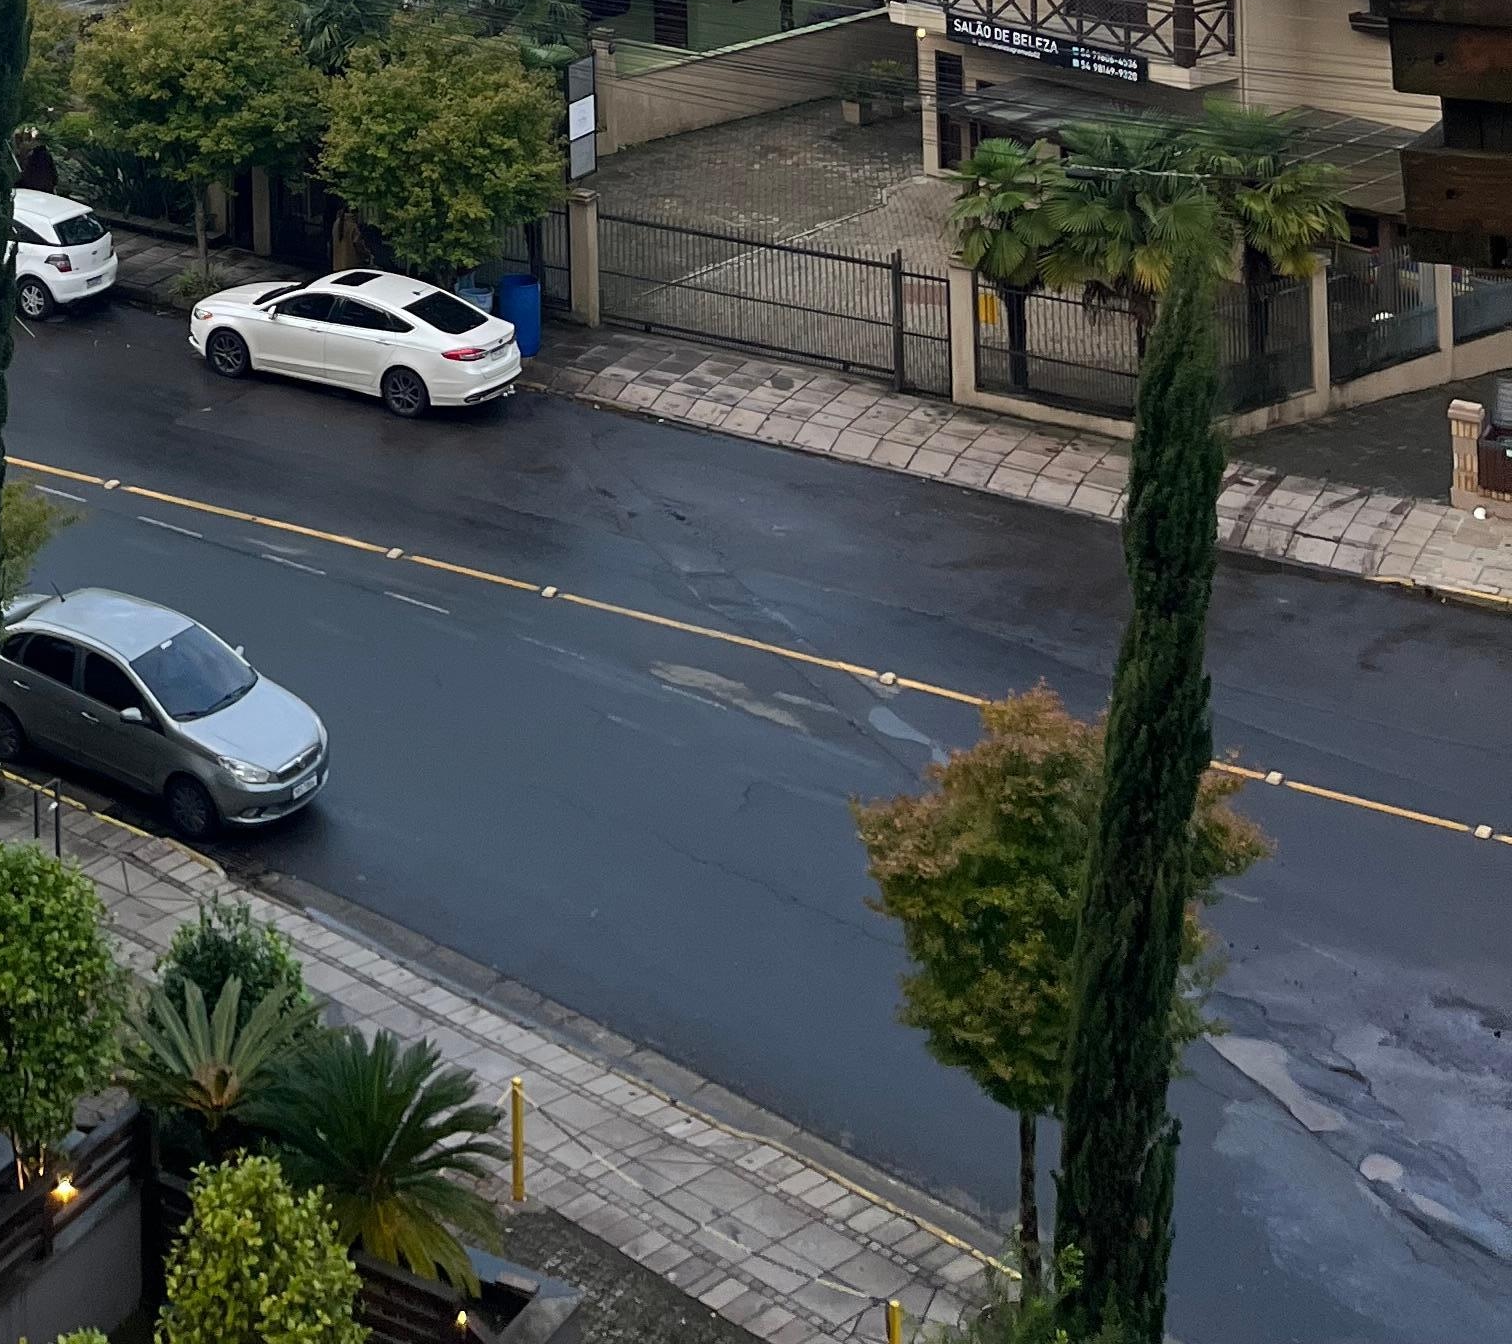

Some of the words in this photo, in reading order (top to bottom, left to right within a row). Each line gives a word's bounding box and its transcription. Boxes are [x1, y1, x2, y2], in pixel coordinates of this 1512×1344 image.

[953, 18, 991, 39] SALÃO
[994, 28, 1010, 43] DE
[1013, 32, 1059, 54] BELEZA
[1080, 58, 1091, 71] 54
